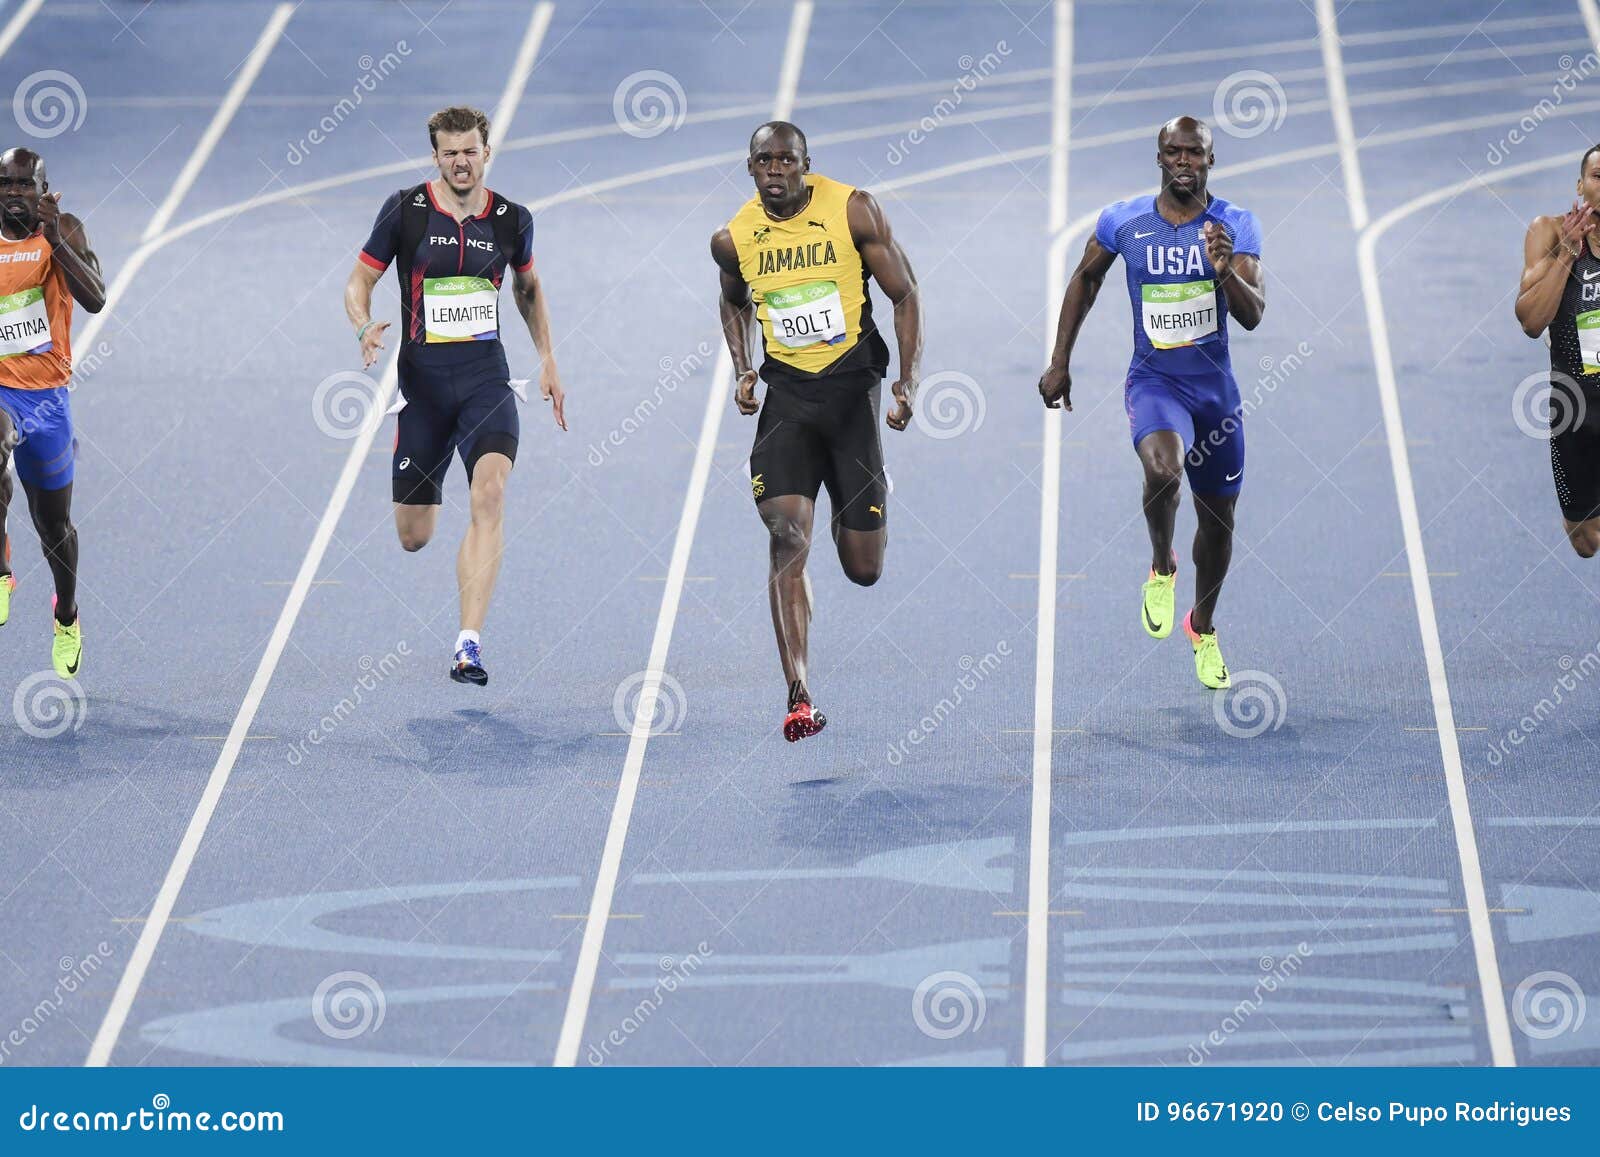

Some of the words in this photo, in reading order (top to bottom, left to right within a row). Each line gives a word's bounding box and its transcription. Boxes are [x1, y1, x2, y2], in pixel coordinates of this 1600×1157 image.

[430, 236, 494, 251] FRANCE
[757, 240, 837, 276] JAMAICA
[1146, 245, 1205, 276] USA
[432, 304, 495, 323] LEMAITRE
[782, 309, 832, 338] BOLT
[1150, 308, 1214, 330] MERRITT
